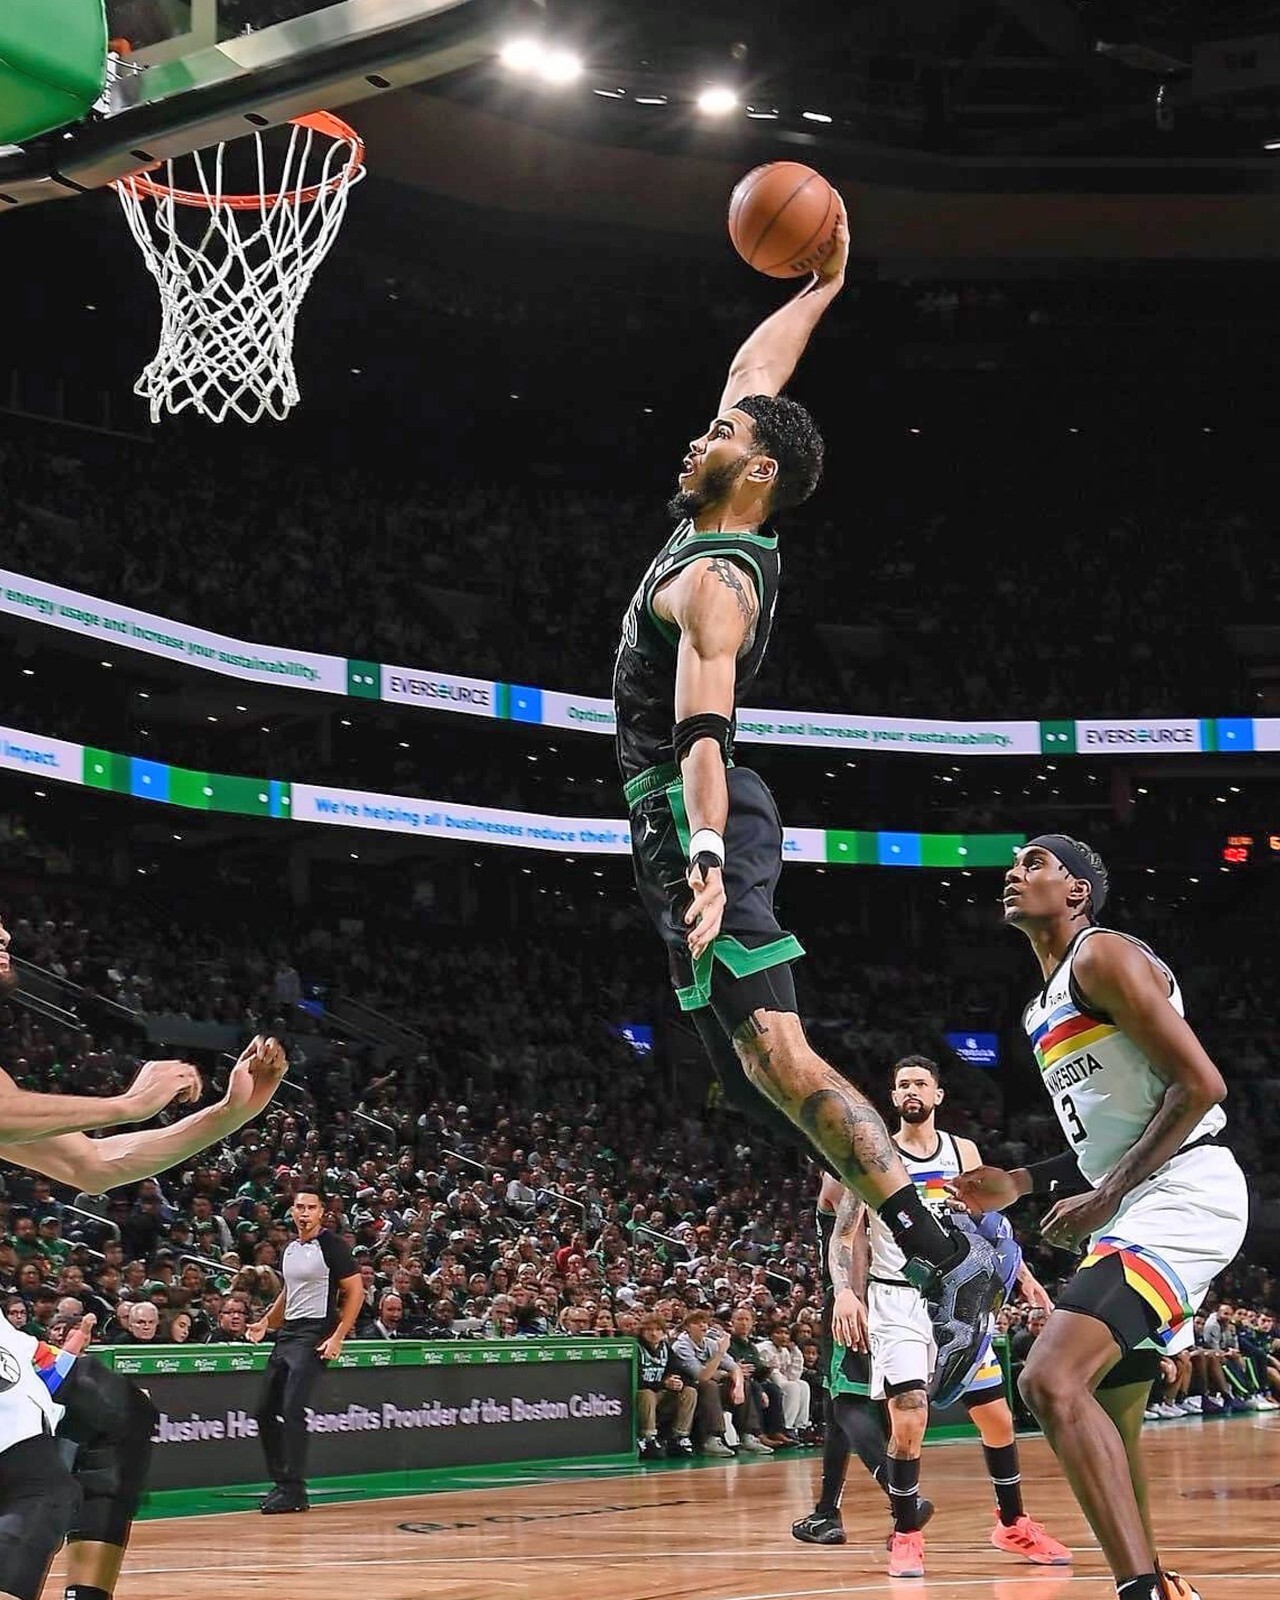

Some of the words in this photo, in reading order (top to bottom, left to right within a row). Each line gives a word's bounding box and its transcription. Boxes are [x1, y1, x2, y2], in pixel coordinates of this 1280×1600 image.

[5, 587, 55, 616] energy
[60, 603, 99, 627] usage
[102, 614, 127, 635] and
[131, 622, 185, 650] increase
[187, 641, 216, 660] your
[219, 649, 321, 682] sustainability.
[390, 675, 490, 706] EVERSOURCE
[568, 705, 616, 724] Optimi
[777, 722, 805, 737] and
[807, 722, 869, 740] increase
[872, 730, 905, 744] your
[907, 730, 1013, 748] sustainability.
[1086, 728, 1194, 744] EVERSOURCE
[313, 796, 359, 817] We're
[362, 803, 419, 827] helping
[424, 812, 442, 827] all
[446, 815, 523, 838] businesses
[527, 825, 575, 843] reduce
[580, 828, 618, 844] their
[1061, 1093, 1088, 1145] 3
[382, 1400, 459, 1429] Provider
[460, 1398, 480, 1425] of
[480, 1397, 511, 1424] the
[511, 1396, 569, 1422] Boston
[569, 1392, 622, 1418] Celtics
